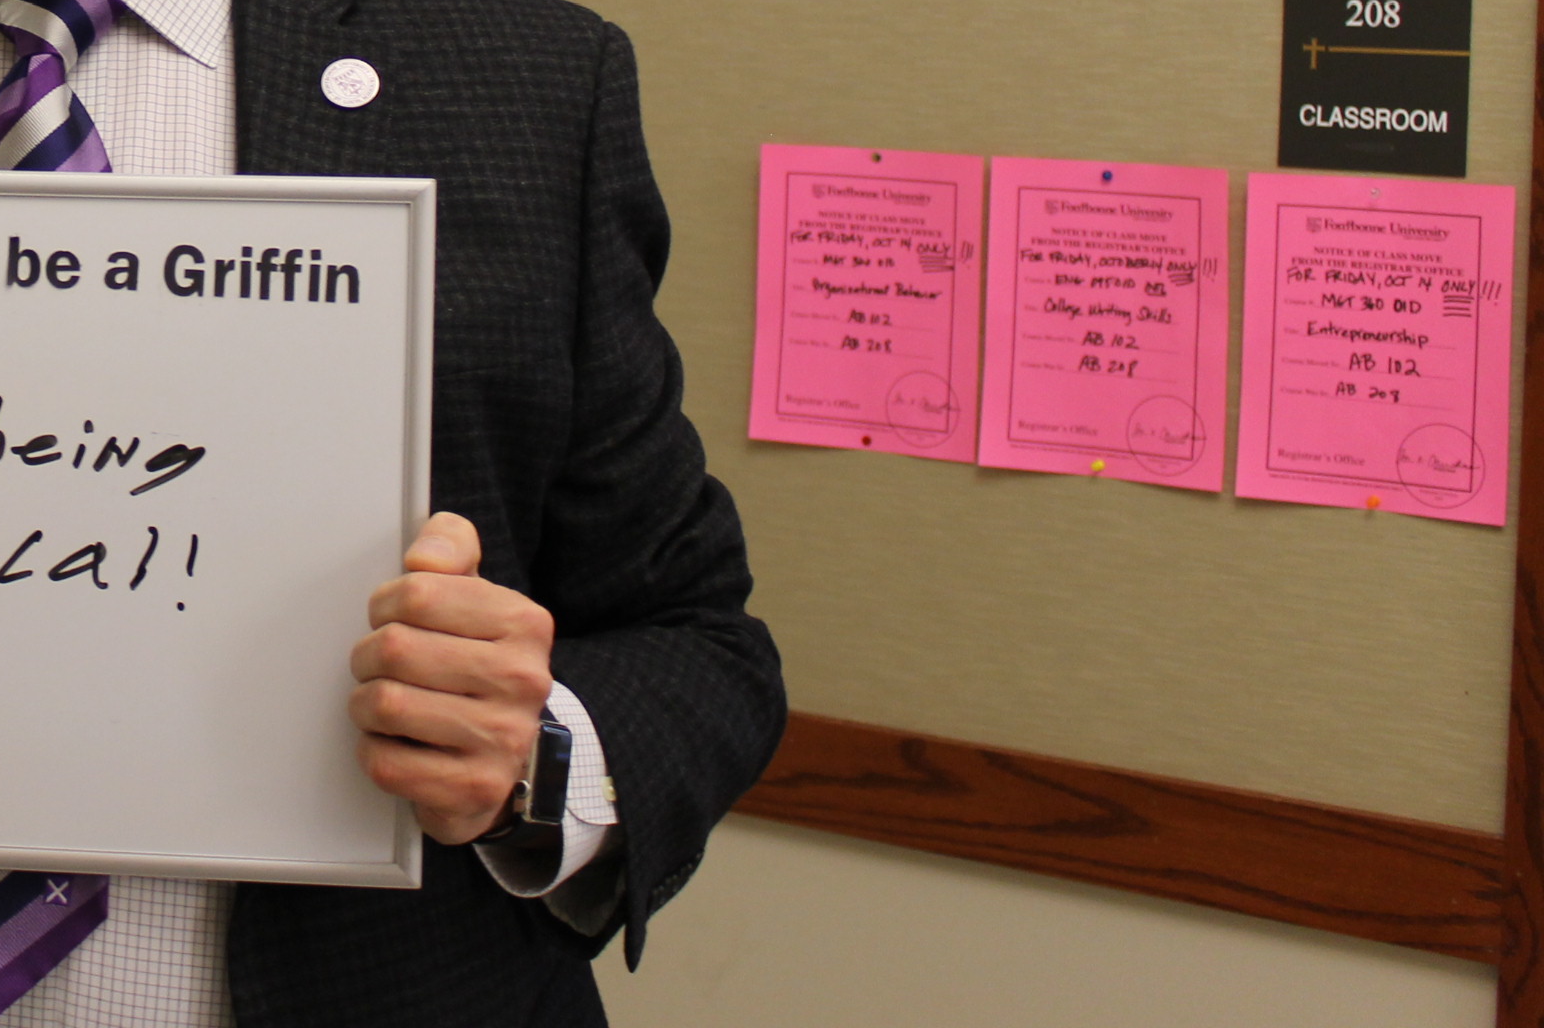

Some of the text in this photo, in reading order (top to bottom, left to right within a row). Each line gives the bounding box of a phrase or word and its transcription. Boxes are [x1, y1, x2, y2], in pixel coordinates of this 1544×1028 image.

[1345, 0, 1400, 28] 208
[1299, 104, 1448, 133] CLASSROOM
[1390, 223, 1450, 239] University
[917, 242, 952, 257] ONLY
[1020, 249, 1044, 263] FOR
[1314, 246, 1443, 263] NOTICE OF CLASS MOVE
[6, 236, 82, 291] be
[104, 250, 140, 293] a
[163, 243, 361, 305] Griffin
[1292, 257, 1323, 267] FROM
[1327, 259, 1348, 268] THE
[1286, 266, 1317, 284] FOR
[1325, 270, 1382, 290] FRIDAY,
[1385, 274, 1413, 288] OCT
[1418, 277, 1432, 291] 14
[1441, 279, 1476, 294] ONLY
[1321, 293, 1356, 310] MGT
[1137, 306, 1172, 324] Skills
[1111, 334, 1140, 350] 102
[1307, 321, 1429, 348] Entrepreneurship
[1108, 360, 1139, 378] 208
[1349, 353, 1421, 377] AB 102
[1335, 381, 1357, 396] AB
[1369, 387, 1400, 403] 208
[1333, 453, 1366, 466] Office
